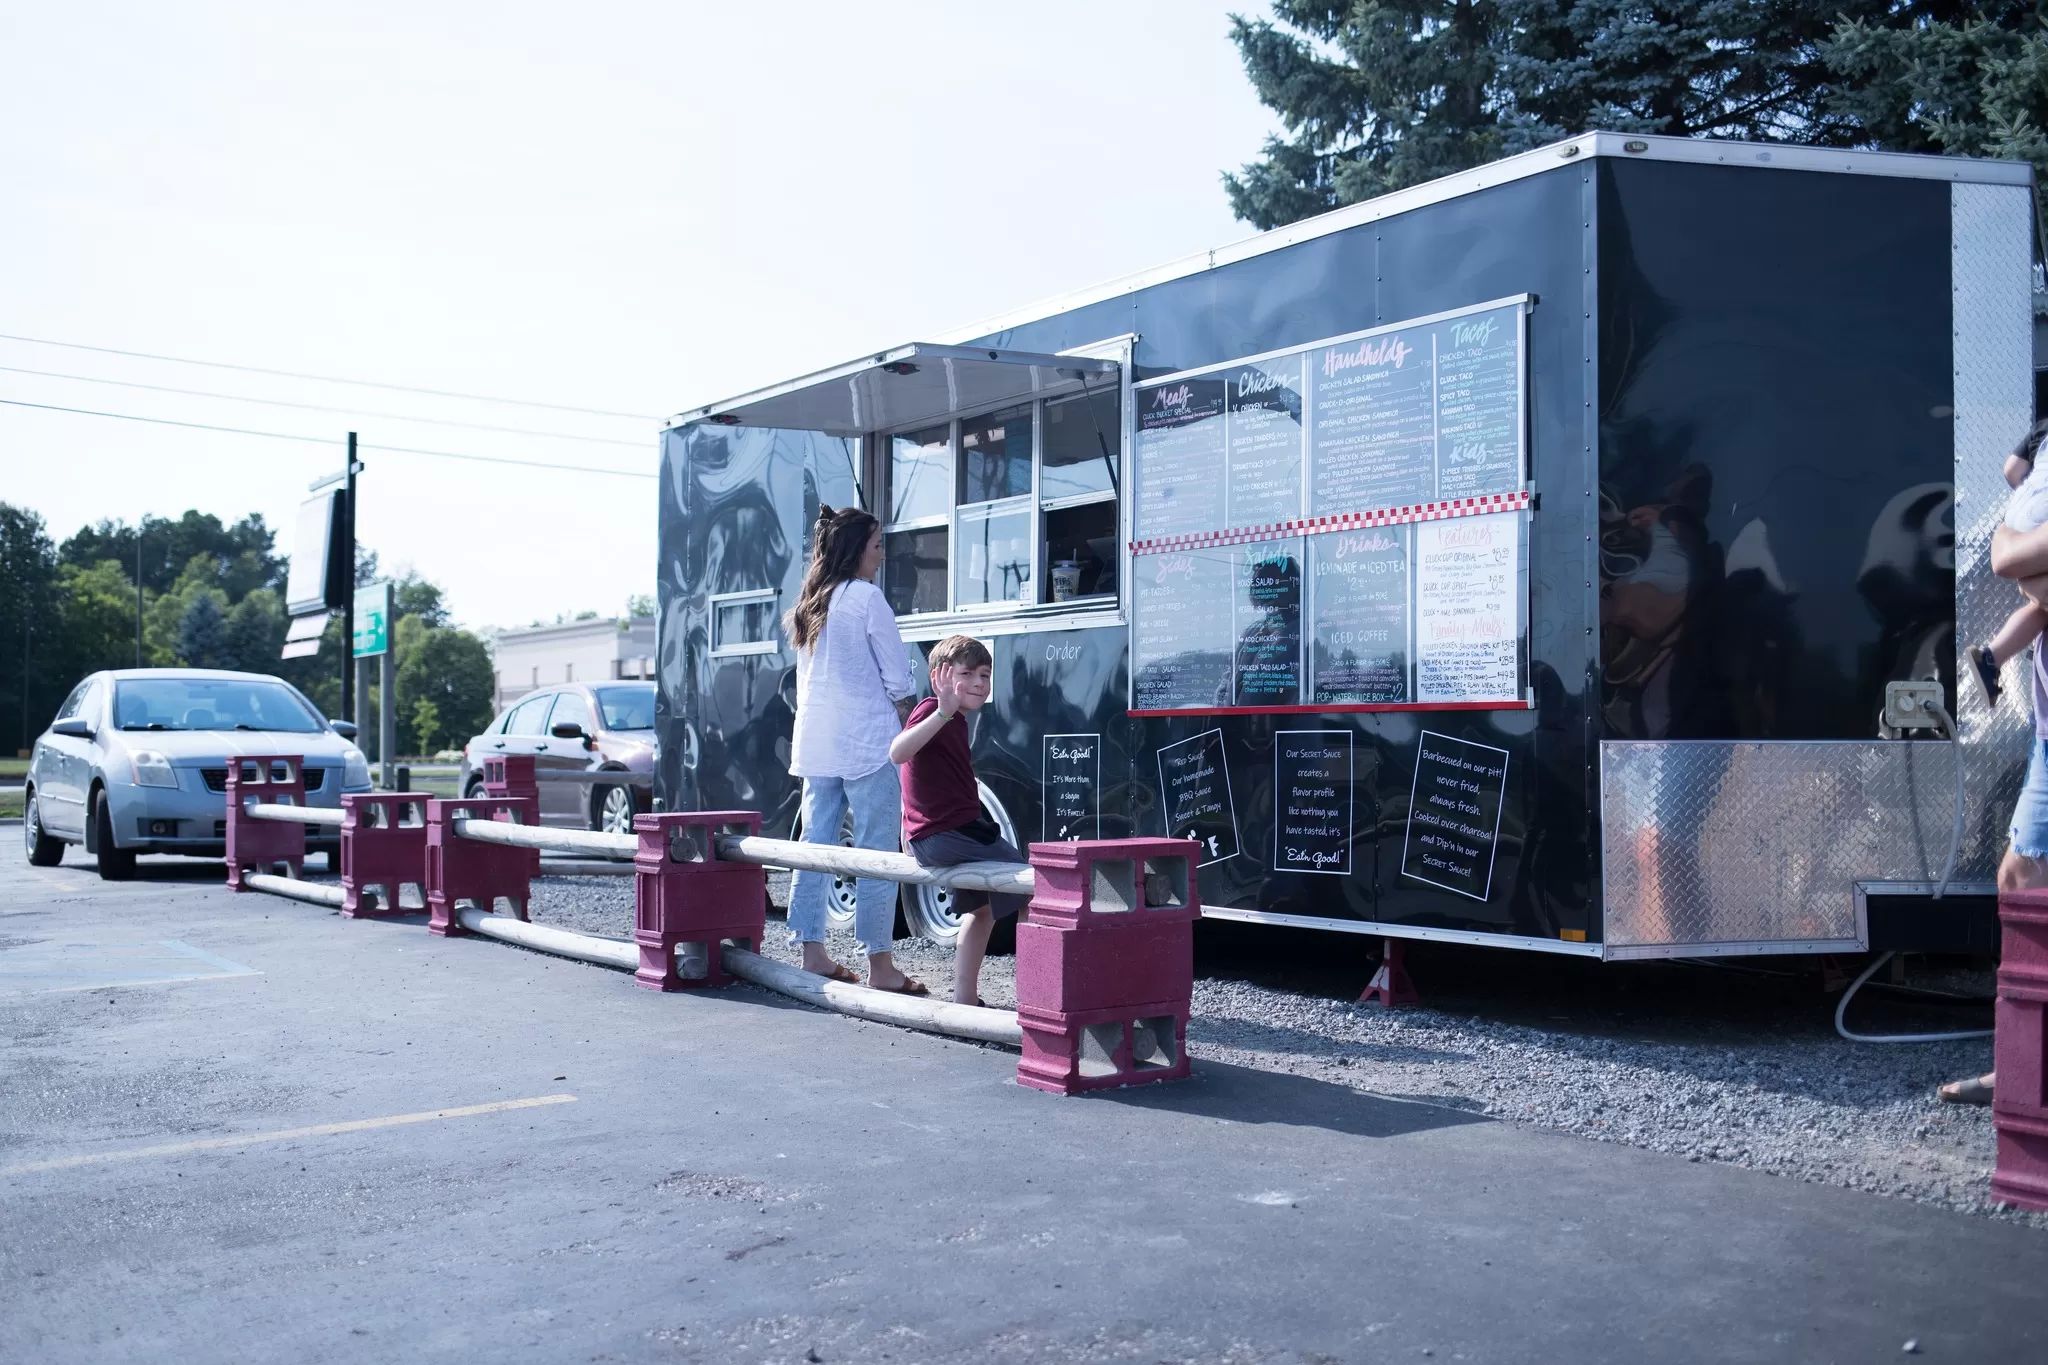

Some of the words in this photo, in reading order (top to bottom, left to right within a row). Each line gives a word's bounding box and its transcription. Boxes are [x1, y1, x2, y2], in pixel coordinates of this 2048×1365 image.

[1450, 317, 1499, 348] Tacos
[1322, 336, 1413, 378] Handhelds
[1439, 352, 1466, 363] CHICKEN
[1467, 348, 1483, 358] TACO
[1238, 371, 1299, 398] Chicken
[1319, 378, 1342, 392] CHICKEN
[1342, 375, 1361, 386] SALAD
[1361, 370, 1390, 383] SANDWICH
[1440, 375, 1458, 385] CLUCK
[1459, 372, 1473, 381] TACO
[1440, 392, 1455, 402] SPICY
[1457, 389, 1471, 397] TACO
[1463, 403, 1476, 411] TACO
[1347, 413, 1370, 424] CHICKEN
[1372, 408, 1400, 419] SANDWICH
[1464, 422, 1477, 430] TACO
[1345, 436, 1370, 445] CHICKEN
[1449, 443, 1494, 464] Kids
[1463, 473, 1476, 481] TACO
[1336, 534, 1400, 559] Drinks
[1316, 560, 1358, 576] LEMONADE
[1367, 561, 1386, 575] ICED
[1387, 560, 1405, 573] TEA
[1255, 577, 1274, 587] SALAD
[1331, 631, 1354, 645] ICED
[1357, 629, 1389, 643] COFFEE
[1046, 643, 1081, 662] Order
[1161, 664, 1177, 674] SALAD
[1239, 664, 1258, 672] CHICKEN
[1272, 663, 1287, 671] SALAD
[1157, 680, 1172, 689] SALAD
[1372, 692, 1385, 702] BOX
[1286, 748, 1298, 759] Our
[1422, 748, 1462, 768] Barbecued
[1462, 760, 1473, 771] on
[1473, 764, 1487, 774] our
[1488, 766, 1503, 779] pit!
[1171, 774, 1183, 787] Our
[1183, 765, 1215, 785] homemade
[1297, 767, 1323, 778] creates
[1324, 769, 1330, 778] a
[1292, 786, 1312, 798] flavor
[1313, 786, 1336, 800] profile
[1436, 775, 1459, 787] never
[1460, 780, 1481, 795] fried,
[1178, 789, 1194, 803] BBQ
[1194, 786, 1212, 799] sauce
[1175, 807, 1194, 823] Sweet
[1202, 800, 1222, 816] Tangy
[1288, 805, 1300, 816] like
[1301, 806, 1327, 820] nothing
[1328, 809, 1339, 820] you
[1429, 793, 1457, 810] always
[1457, 800, 1481, 817] fresh.
[1414, 810, 1441, 826] Cooked
[1441, 820, 1459, 831] over
[1286, 824, 1303, 837] have
[1303, 825, 1328, 838] tasted,
[1329, 826, 1341, 837] it's
[1420, 834, 1435, 845] and
[1436, 836, 1456, 852] Dip'n
[1456, 842, 1464, 854] in
[1465, 847, 1479, 858] our
